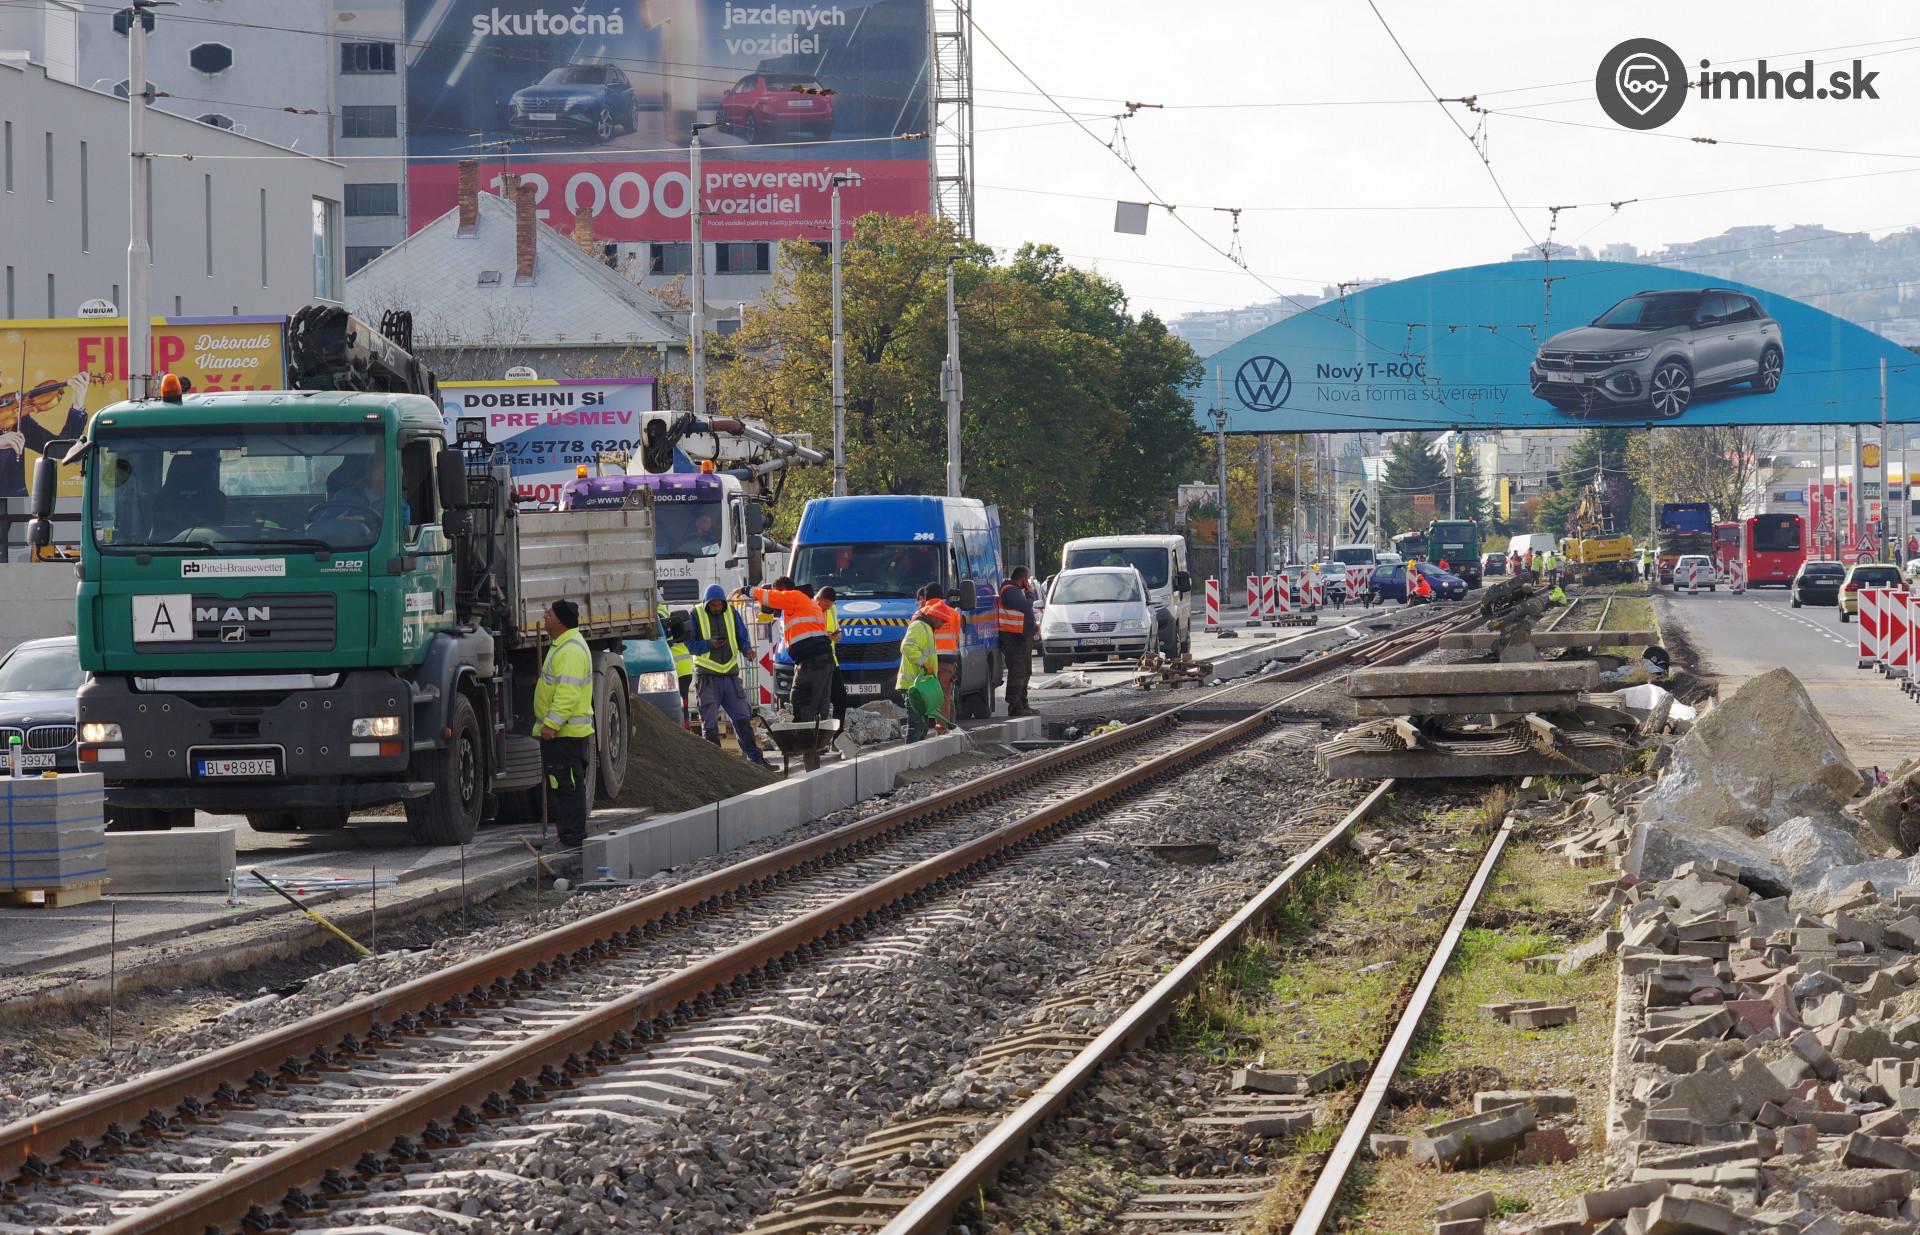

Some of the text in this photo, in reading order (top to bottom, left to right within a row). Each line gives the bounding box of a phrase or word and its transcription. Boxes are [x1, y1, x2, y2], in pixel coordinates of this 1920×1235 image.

[472, 6, 624, 36] skutočná
[723, 1, 846, 31] jazdených
[725, 33, 820, 55] vozidiel
[706, 166, 862, 193] preverených
[565, 171, 693, 219] 000
[706, 193, 800, 214] vozidiel
[194, 333, 272, 351] Dokonalé
[195, 354, 259, 369] Vianoce
[1316, 362, 1426, 382] Nový T-ROC
[464, 392, 574, 408] DOBEHNI
[1317, 384, 1509, 403] Nová forma suverenity
[490, 408, 632, 427] PRE ÚSMEV
[537, 456, 545, 465] 5
[183, 562, 283, 576] pb Pittel+Brausewetter
[151, 602, 175, 634] A
[196, 606, 270, 622] MAN
[207, 760, 273, 776] BL 898XE
